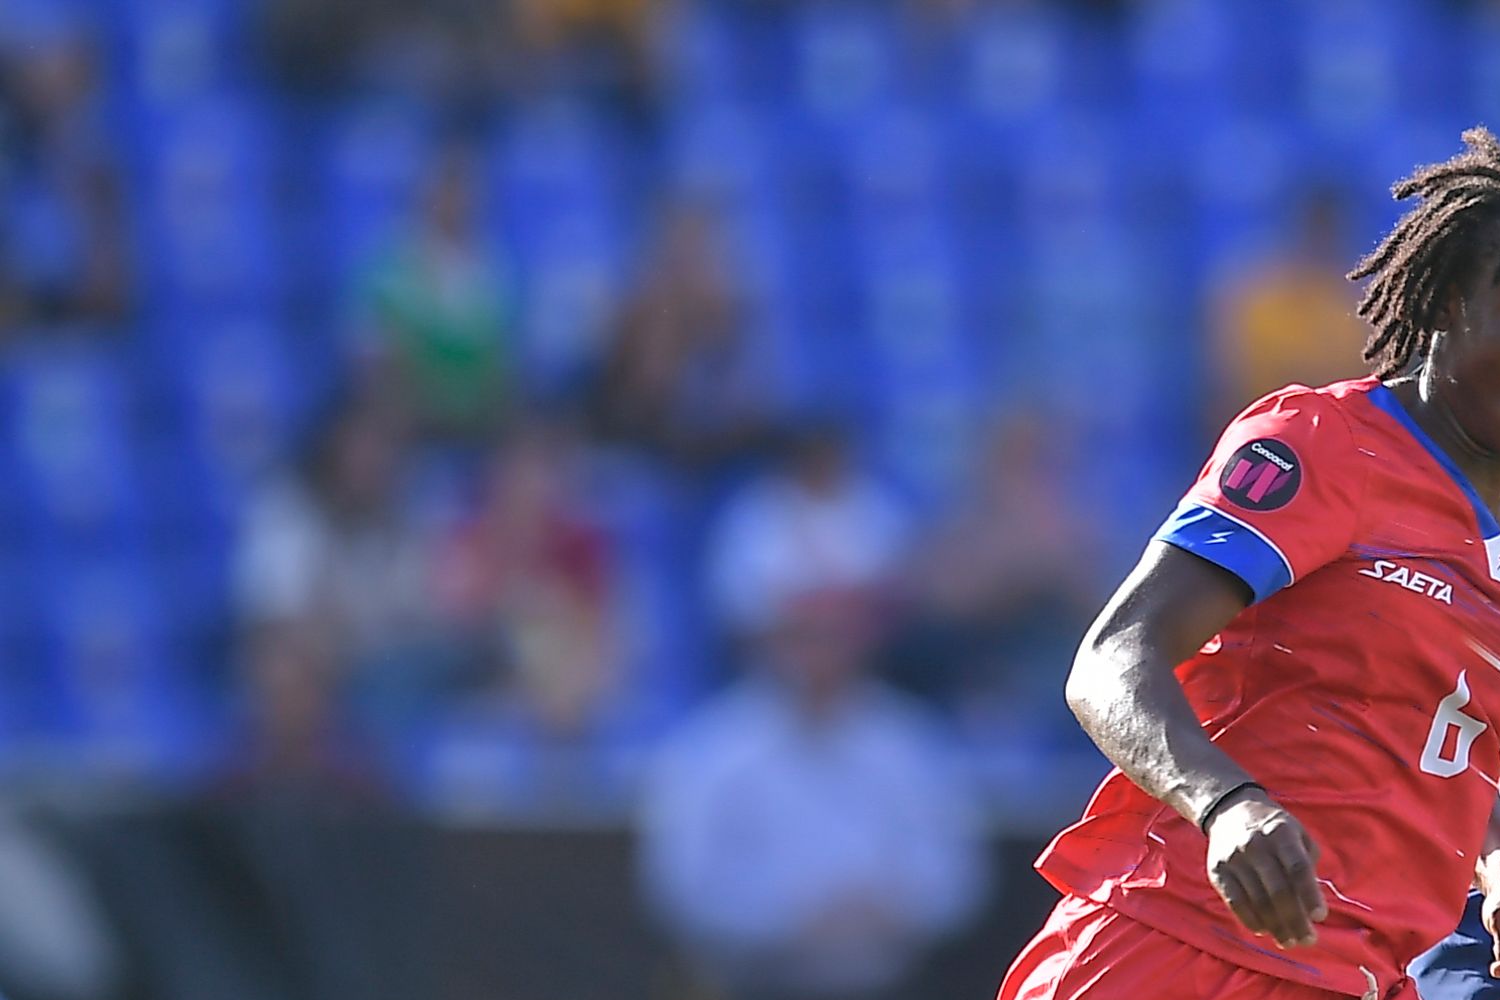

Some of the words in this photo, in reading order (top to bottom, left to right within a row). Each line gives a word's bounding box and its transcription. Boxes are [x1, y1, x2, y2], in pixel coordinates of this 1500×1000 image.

[1251, 442, 1294, 472] Concacaf
[1357, 559, 1453, 605] SAETA
[1419, 668, 1488, 778] 6
